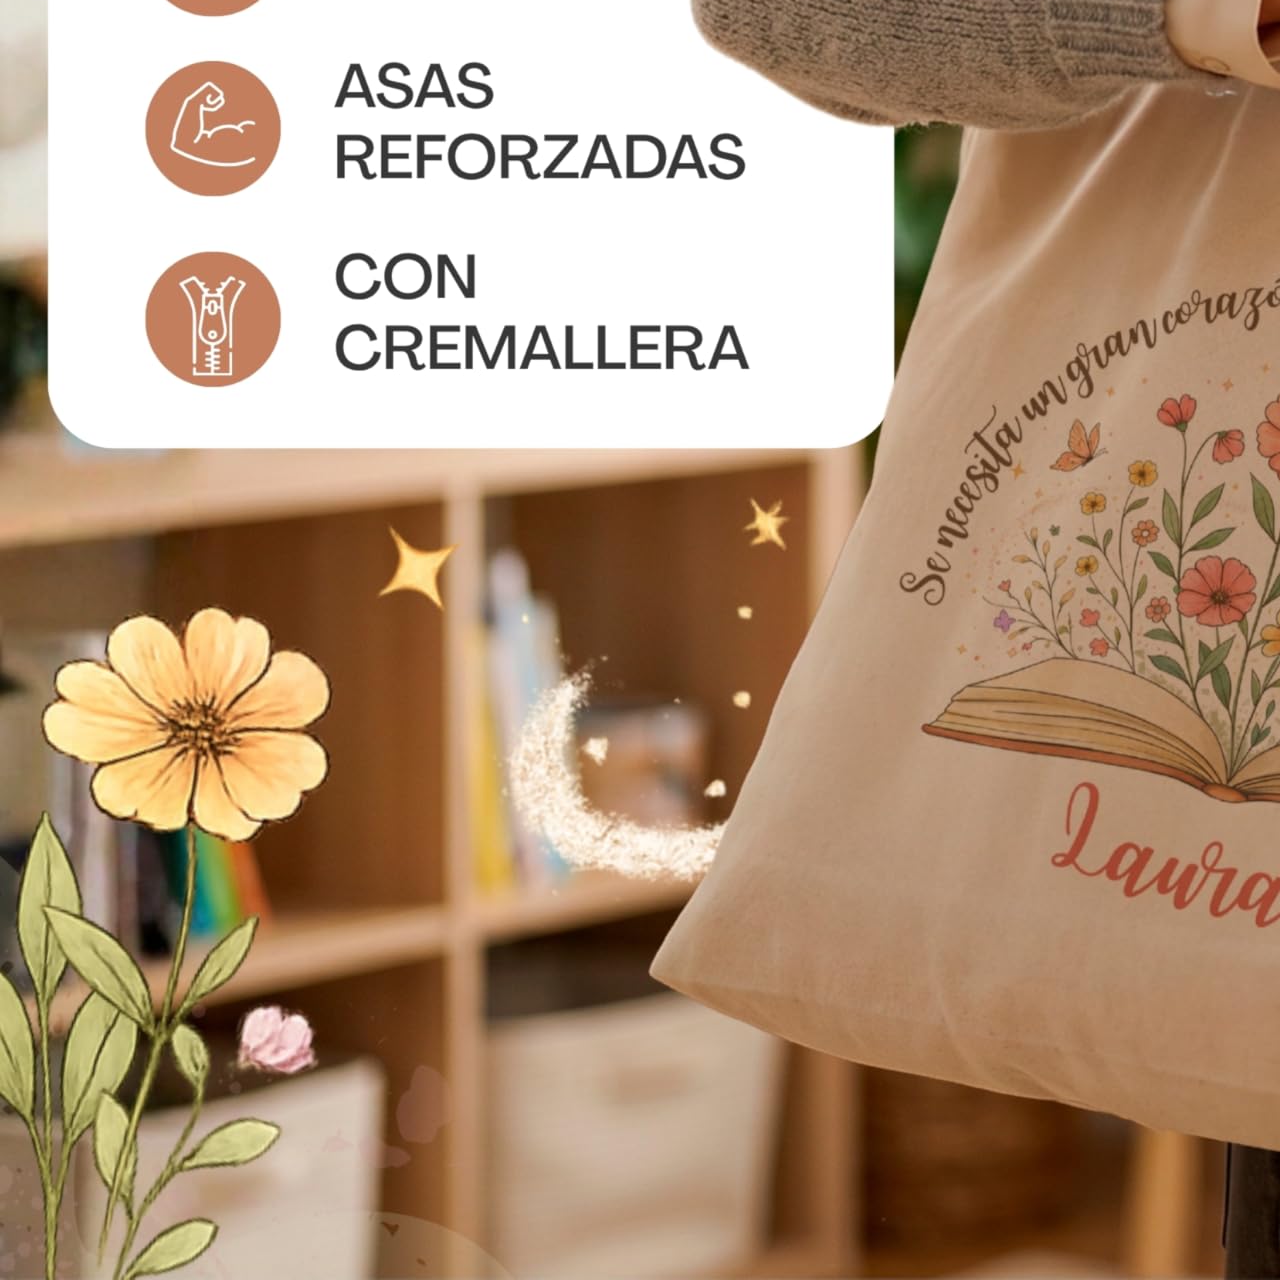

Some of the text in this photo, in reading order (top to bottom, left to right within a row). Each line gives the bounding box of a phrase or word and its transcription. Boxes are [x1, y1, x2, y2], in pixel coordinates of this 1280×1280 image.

[900, 552, 951, 606] Se
[938, 404, 1023, 549] necesita
[1021, 375, 1068, 422] un
[1066, 318, 1157, 399] gran
